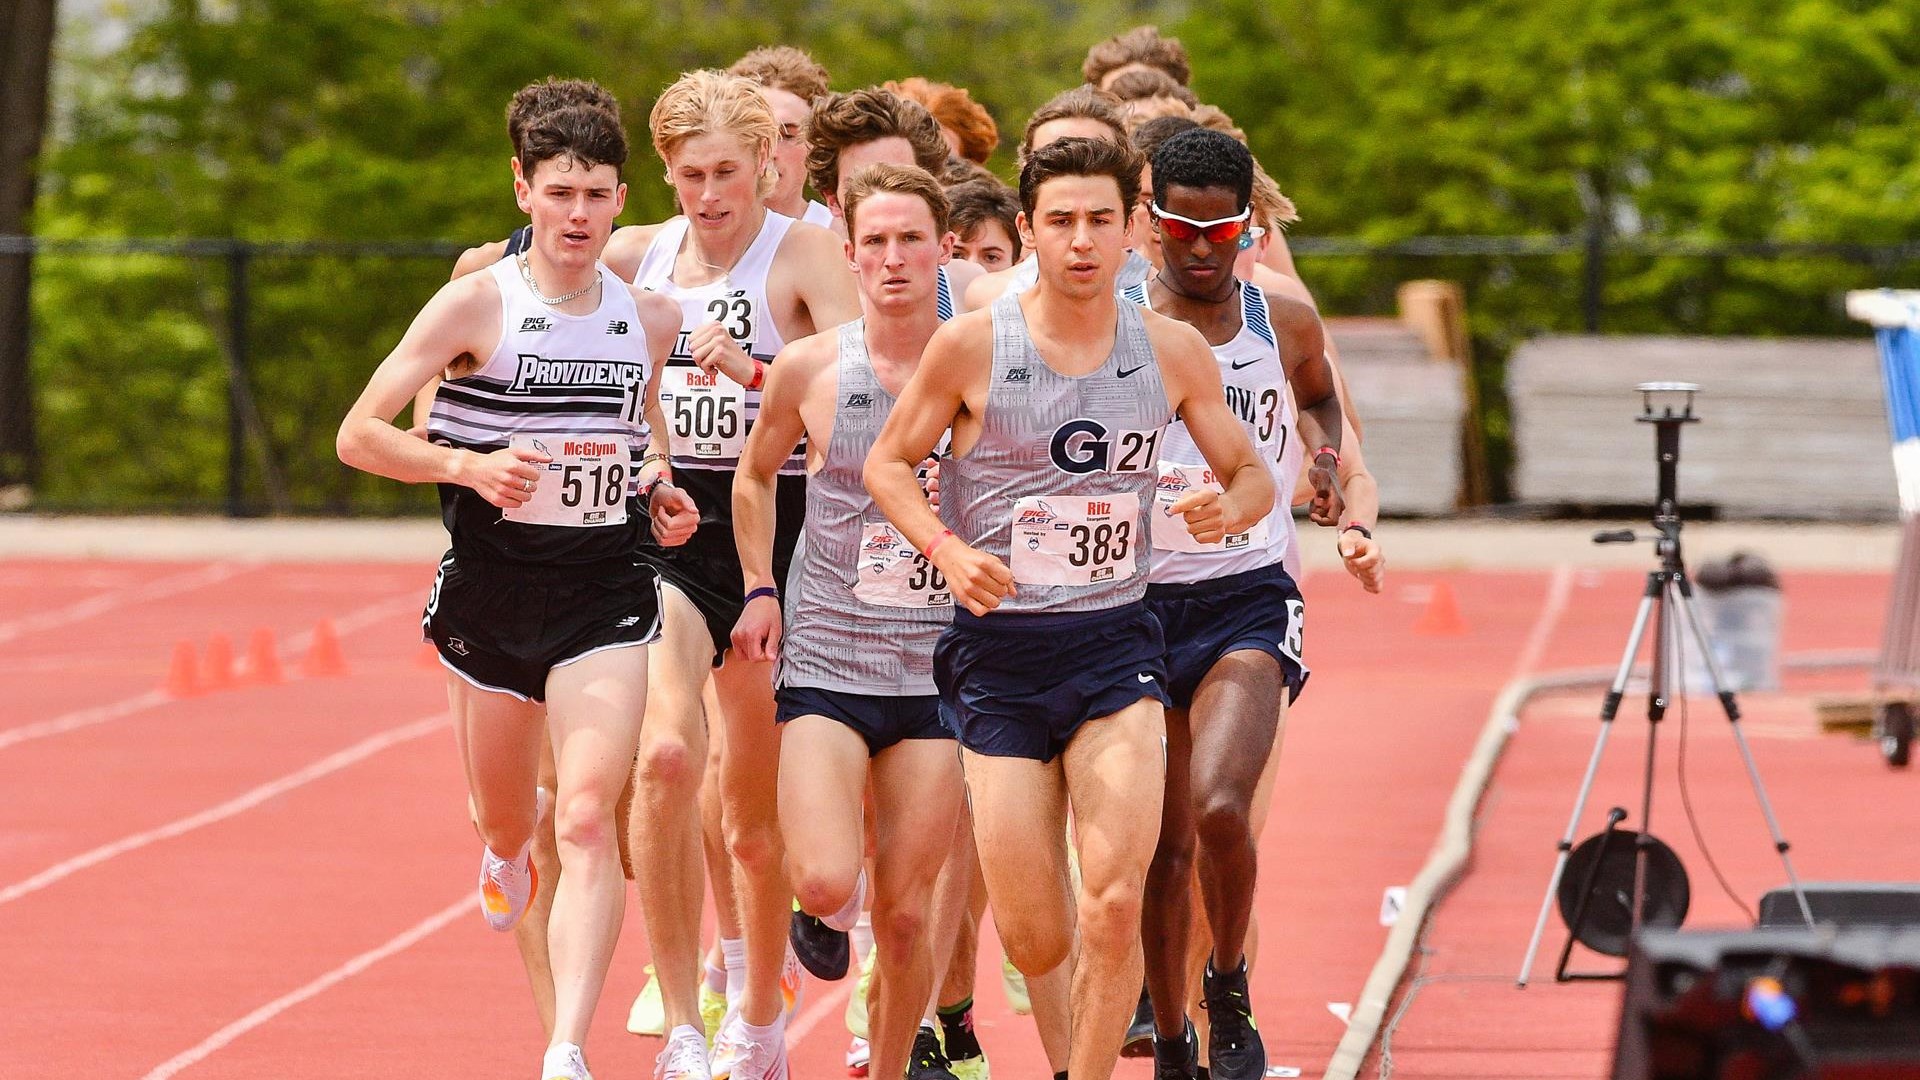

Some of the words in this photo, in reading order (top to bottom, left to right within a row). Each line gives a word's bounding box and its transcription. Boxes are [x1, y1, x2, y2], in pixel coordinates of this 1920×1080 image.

[520, 323, 553, 331] EAST
[707, 299, 752, 340] 23
[506, 353, 644, 394] PROVIDENCE
[674, 396, 738, 439] 505
[1259, 389, 1278, 442] 3
[563, 442, 617, 457] McGlynn
[1050, 418, 1110, 475] G
[1116, 430, 1158, 472] 21
[561, 464, 624, 507] 518
[1156, 483, 1187, 492] EAST
[1160, 476, 1182, 484] BIG
[1087, 502, 1111, 515] Ritz
[865, 542, 897, 550] EAST
[871, 535, 893, 543] BIG
[1068, 520, 1131, 566] 383
